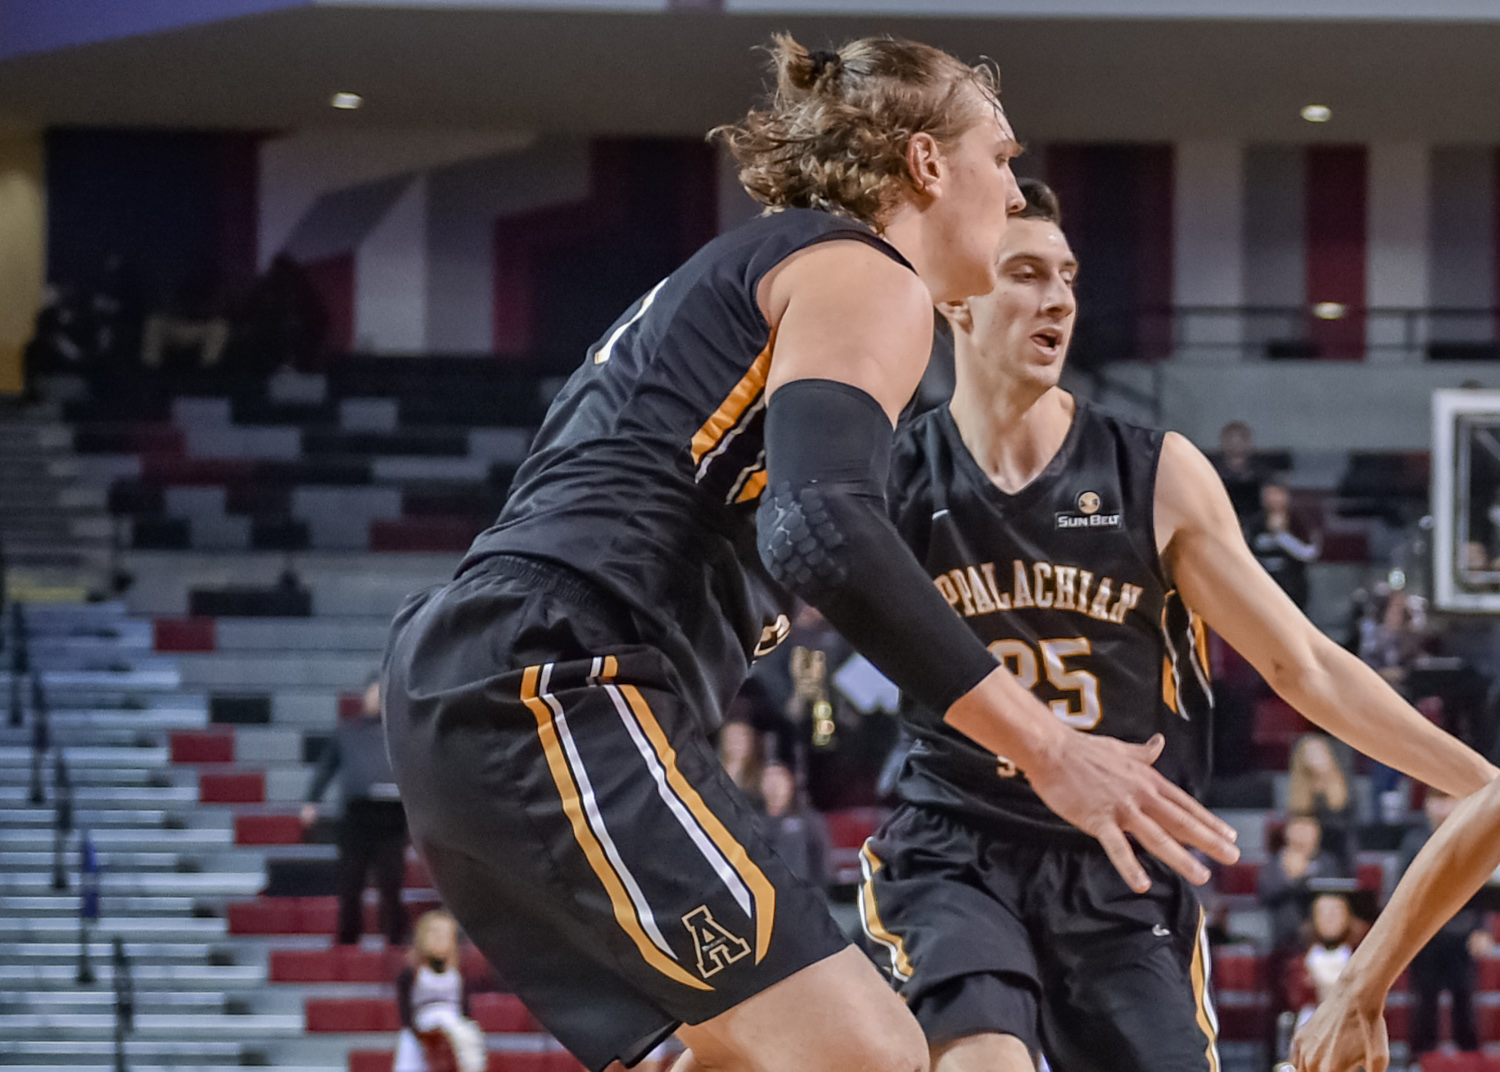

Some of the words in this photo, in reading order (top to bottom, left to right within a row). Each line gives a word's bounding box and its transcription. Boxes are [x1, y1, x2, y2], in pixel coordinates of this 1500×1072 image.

[1057, 515, 1088, 528] SUN
[1090, 514, 1120, 527] BELT
[934, 559, 1144, 625] PPALACHIAN
[681, 904, 752, 979] A
